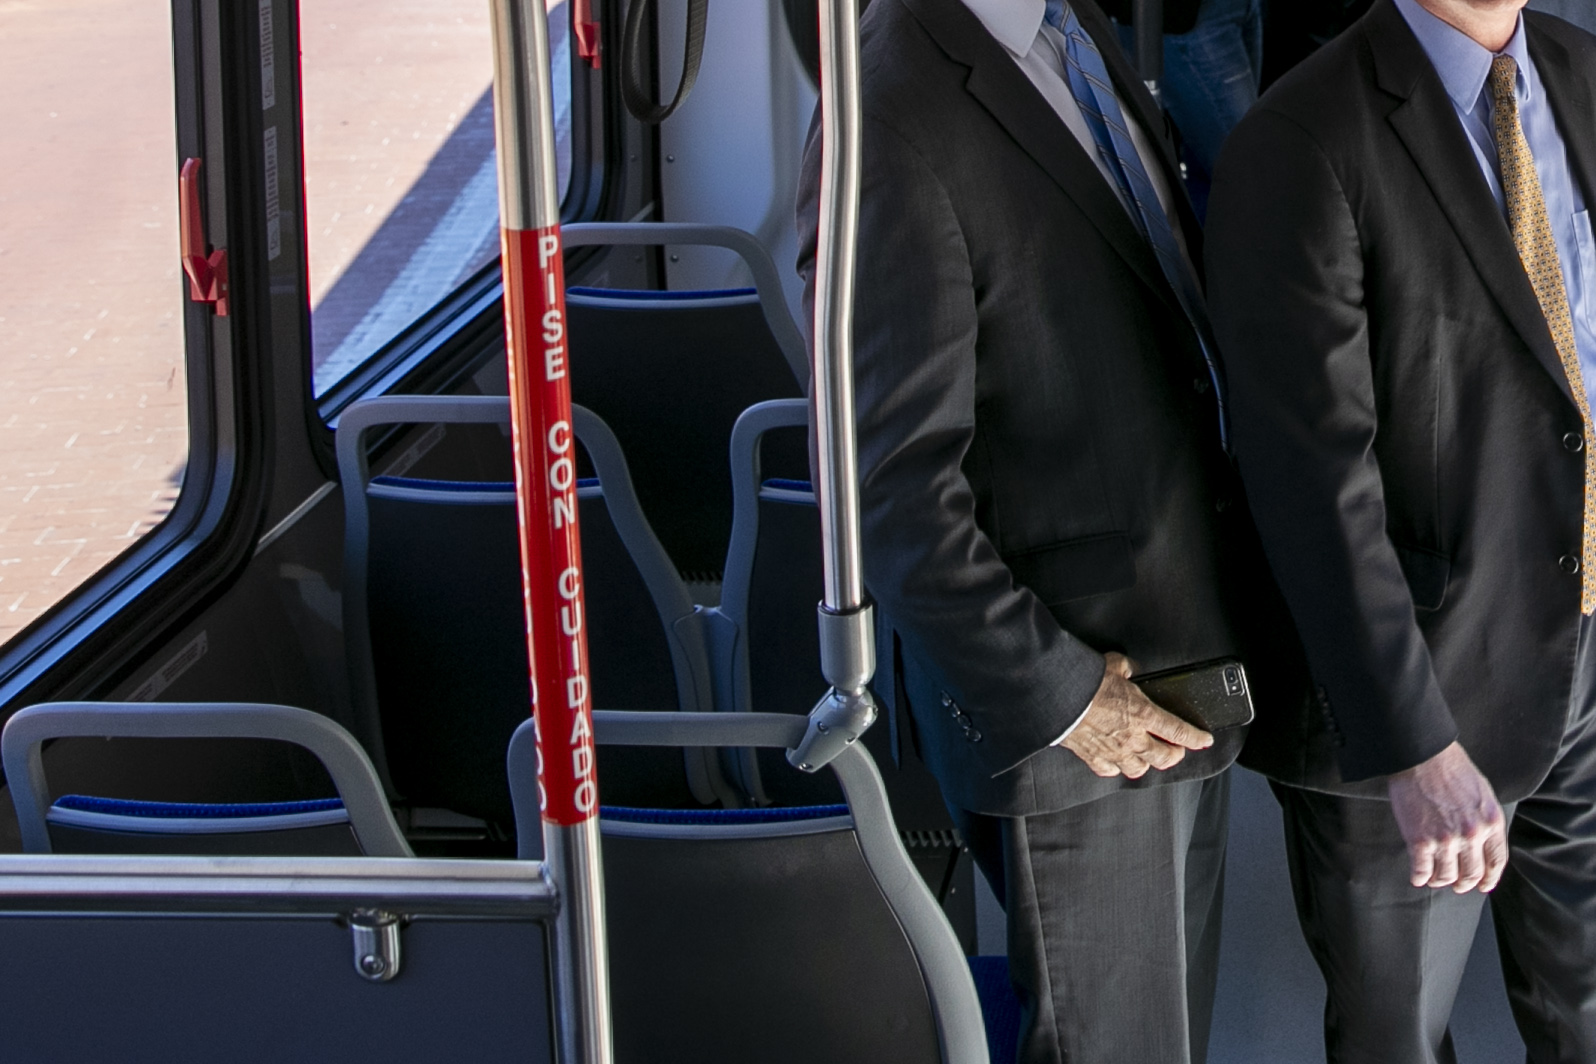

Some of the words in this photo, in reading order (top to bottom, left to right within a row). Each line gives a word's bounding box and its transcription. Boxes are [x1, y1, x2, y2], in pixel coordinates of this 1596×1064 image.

[538, 234, 566, 382] PISE
[547, 420, 576, 530] CON
[558, 566, 597, 813] CUIDADO
